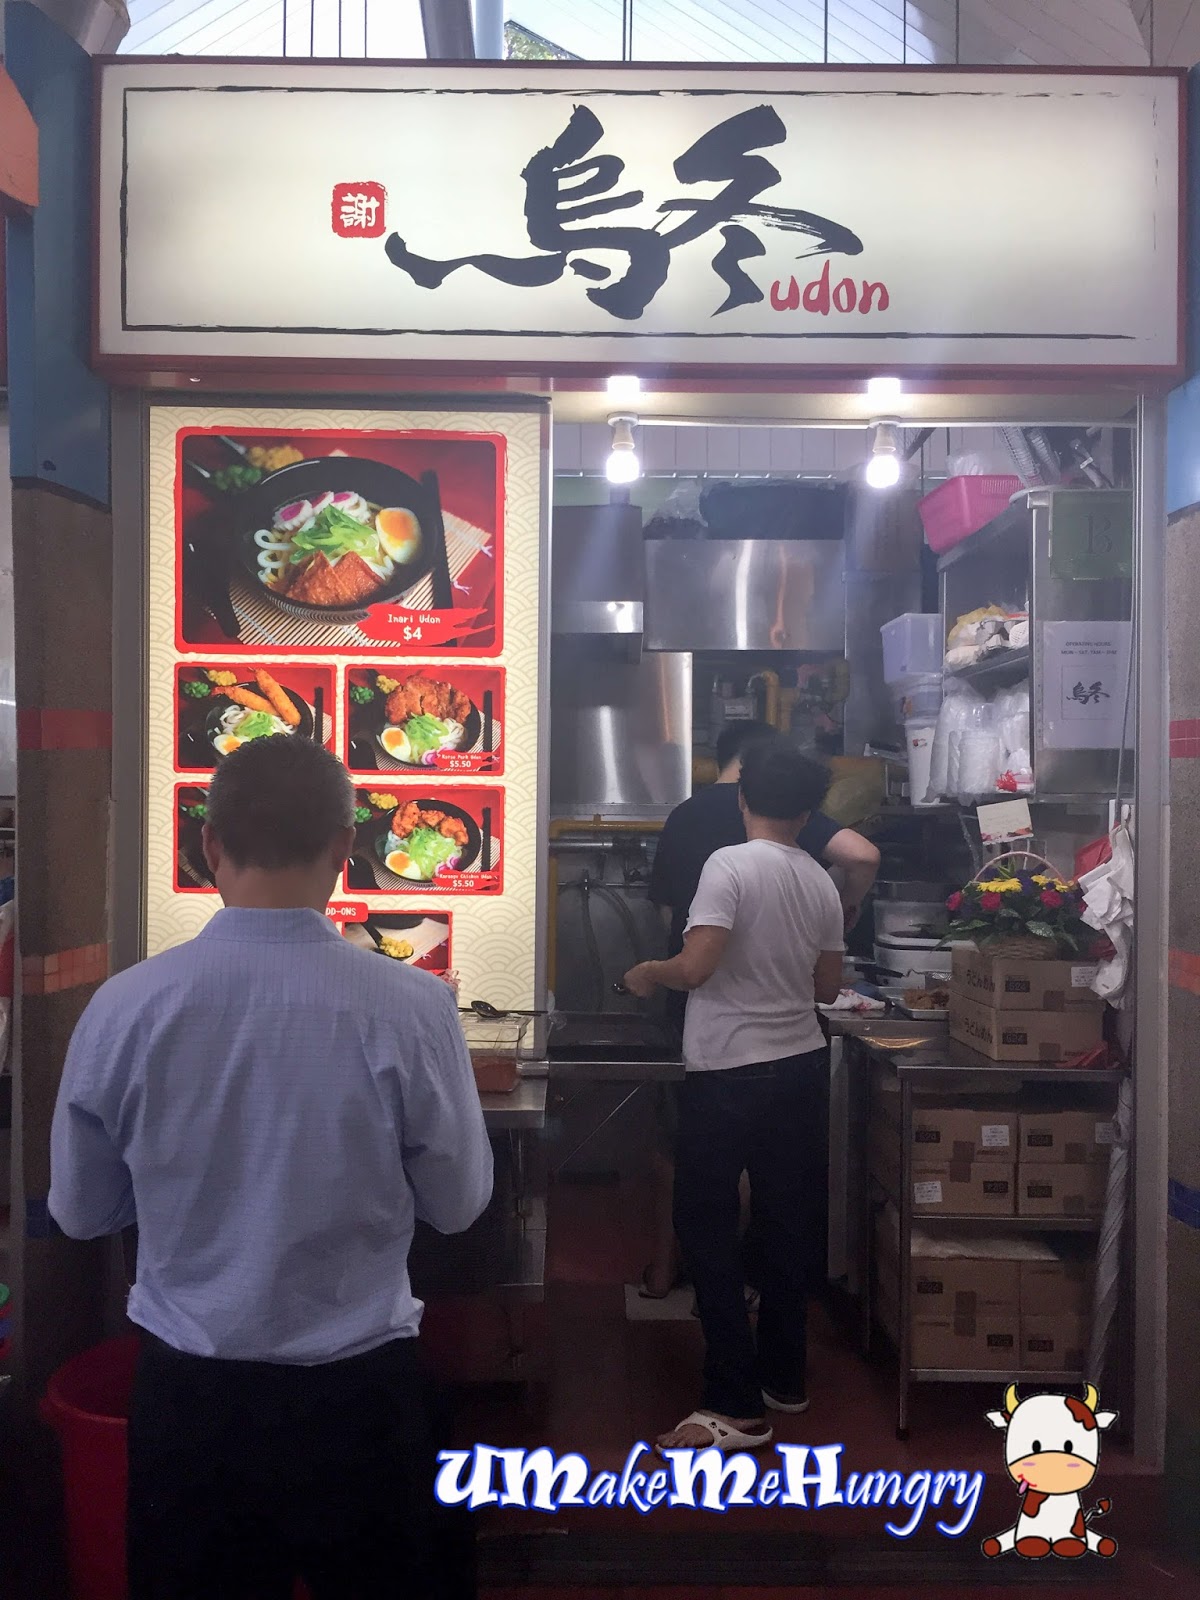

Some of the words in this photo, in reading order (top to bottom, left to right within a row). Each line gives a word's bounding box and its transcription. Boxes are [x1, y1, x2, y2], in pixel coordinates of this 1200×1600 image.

[337, 190, 382, 231] 謝
[769, 258, 890, 317] udon
[387, 613, 414, 624] Inari
[419, 613, 441, 624] Udon
[403, 625, 422, 641] $4
[449, 760, 472, 768] $5.50
[325, 907, 357, 916] DD-ONS
